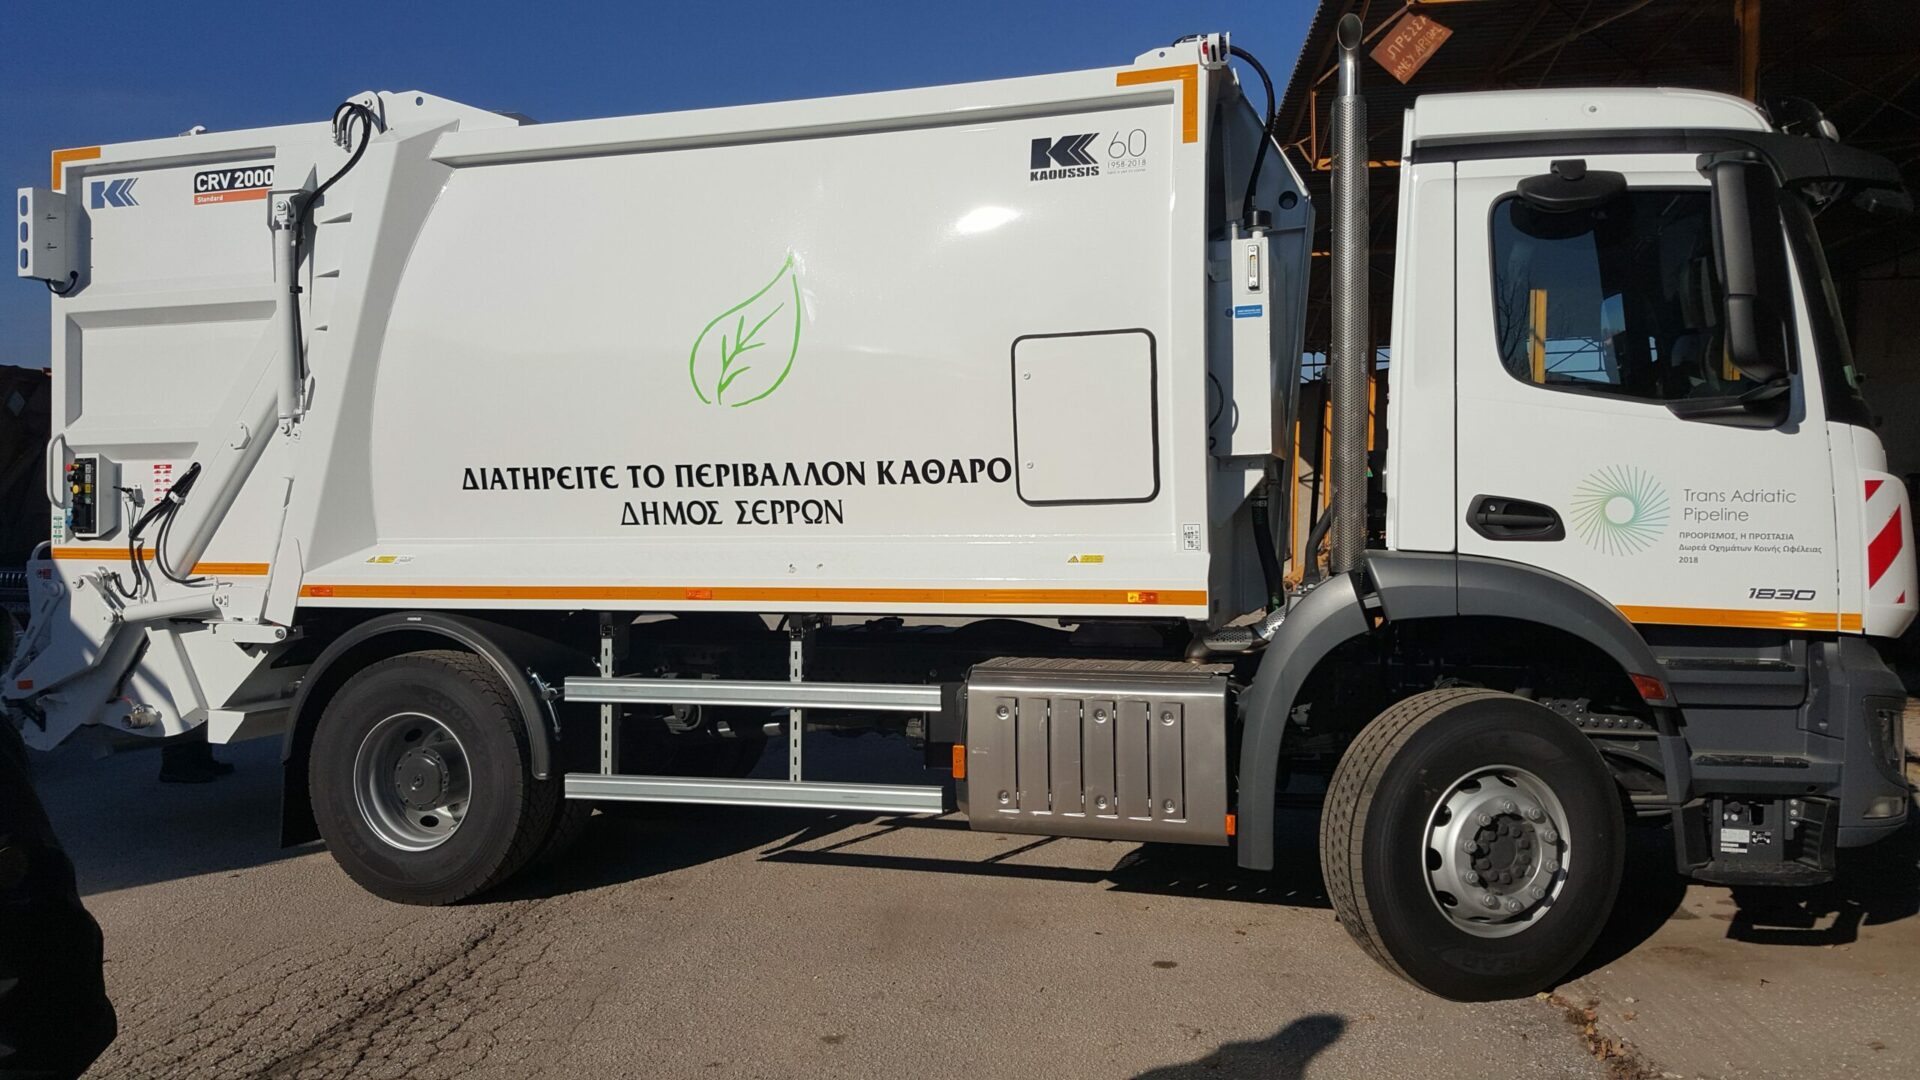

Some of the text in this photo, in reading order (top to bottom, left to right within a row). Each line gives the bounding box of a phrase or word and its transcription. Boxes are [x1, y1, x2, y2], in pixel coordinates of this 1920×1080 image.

[1108, 128, 1147, 159] 60
[196, 168, 274, 191] CRV 2000
[1030, 166, 1100, 181] KAOUSSIS
[462, 457, 1012, 490] ΔΙΑΤΗΡΕΙΤΕ ΤΟ ΠΕΡΙΒΑΛΛΟΝ ΚΑΘΑΡΟ
[1683, 488, 1797, 504] Trans Adriatic
[620, 499, 844, 526] ΔΗΜΟΣ ΣΕΡΡΩΝ
[1683, 507, 1750, 524] Pipeline
[1679, 531, 1794, 541] ΠΡΟΟΡΙΣΜΟΣ, Η ΠΡΟΣΤΑΣΙΑ
[1678, 556, 1699, 564] 2018
[1749, 588, 1816, 601] 1830
